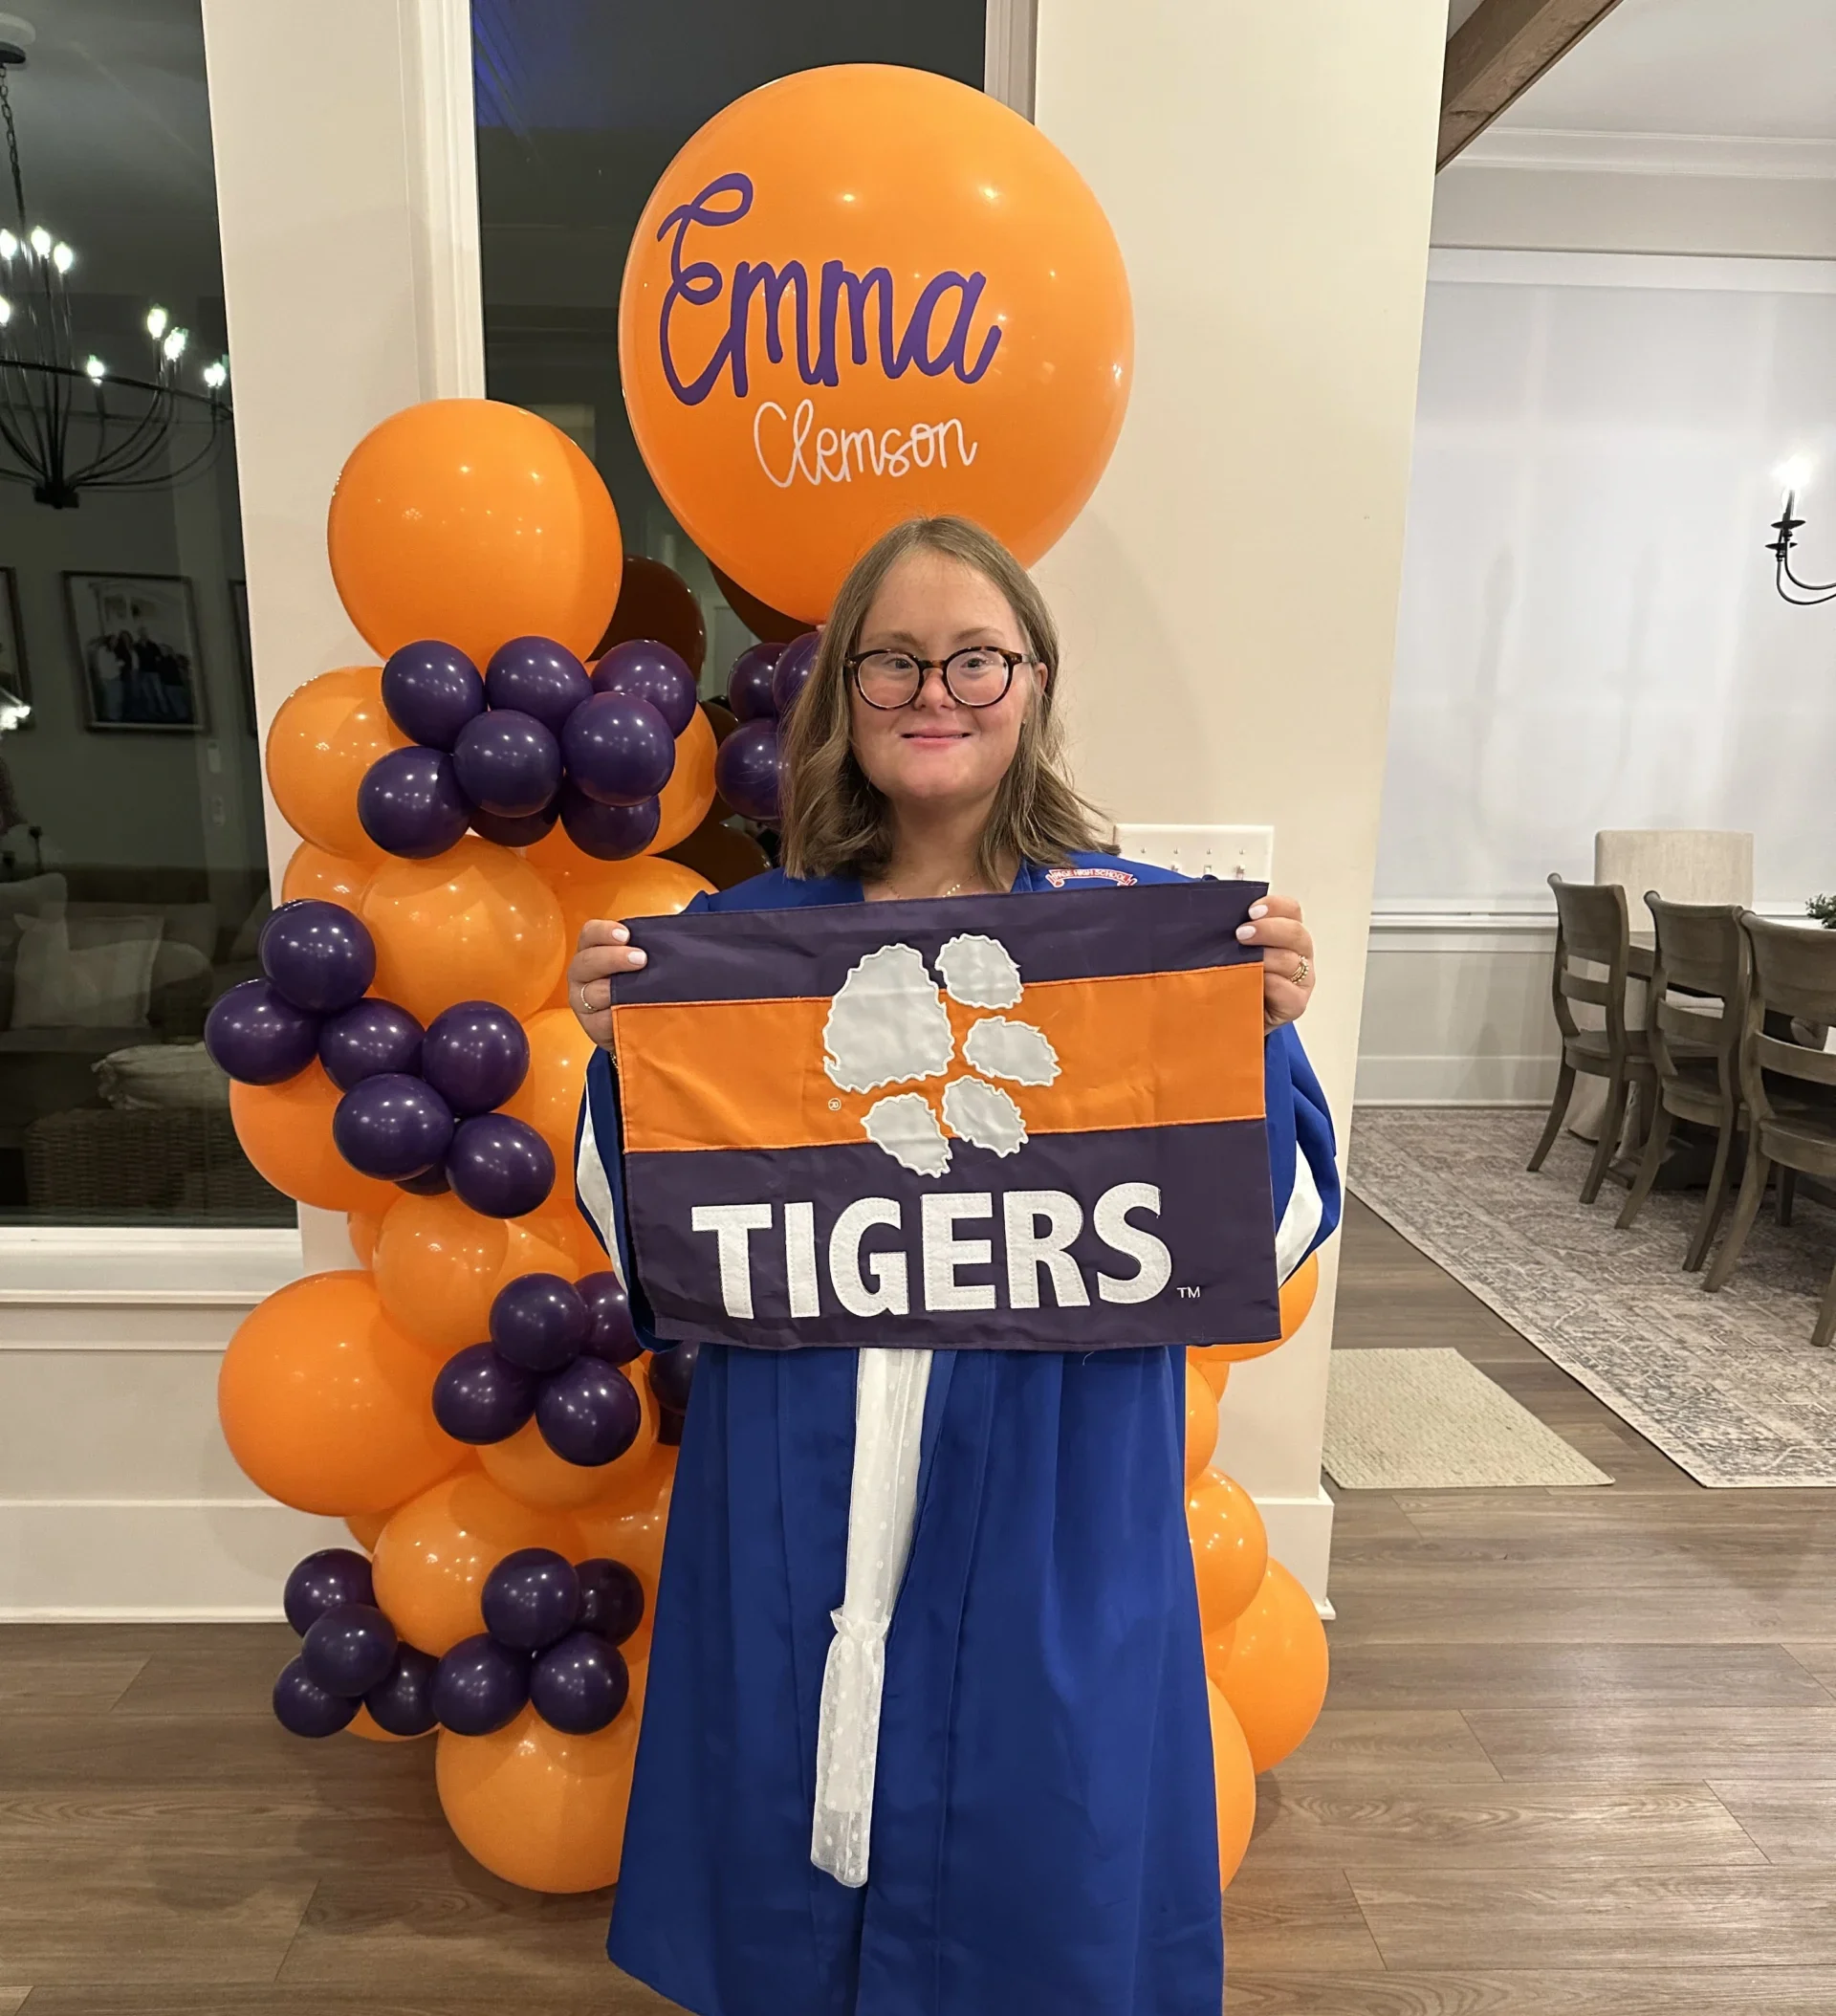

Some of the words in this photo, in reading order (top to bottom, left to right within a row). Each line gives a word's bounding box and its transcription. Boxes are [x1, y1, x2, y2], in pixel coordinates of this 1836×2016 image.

[657, 172, 1002, 405] Emma
[754, 399, 977, 487] Clemson
[1095, 869, 1126, 882] SCHOOL
[691, 1182, 1172, 1319] TIGERS
